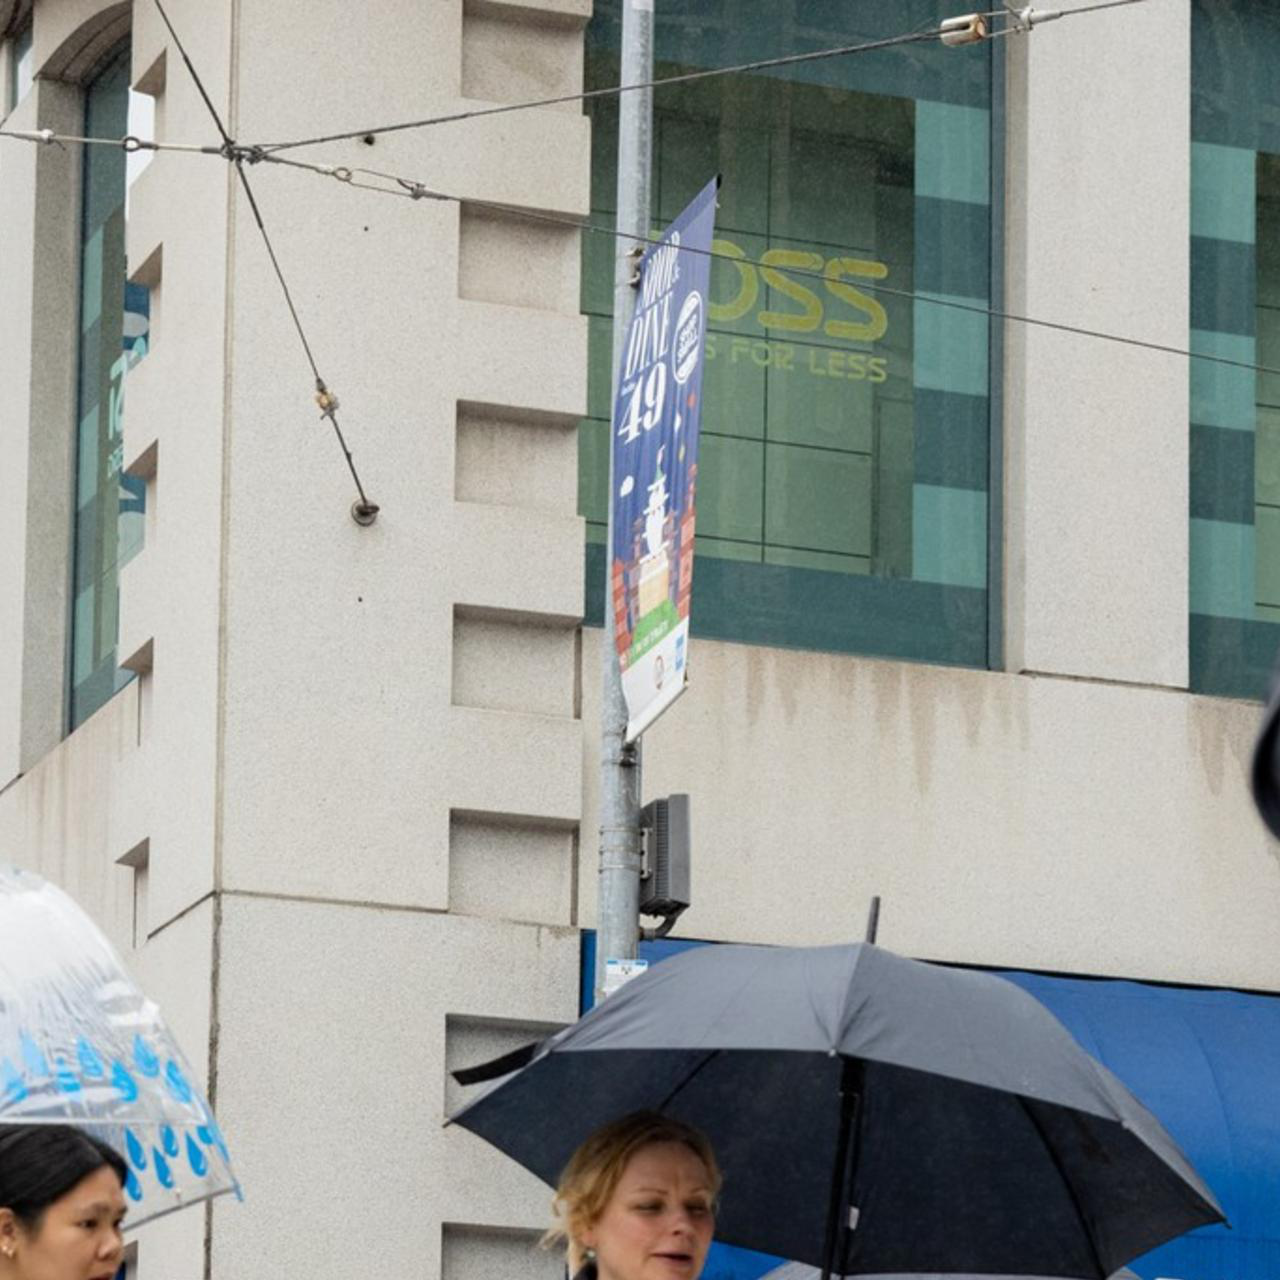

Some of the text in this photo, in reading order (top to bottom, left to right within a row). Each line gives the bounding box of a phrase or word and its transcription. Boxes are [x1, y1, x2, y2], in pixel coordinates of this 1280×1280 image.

[708, 239, 888, 341] OSS
[624, 291, 672, 382] DINE
[731, 338, 794, 371] FOR
[810, 350, 888, 383] LESS
[617, 362, 666, 444] 49
